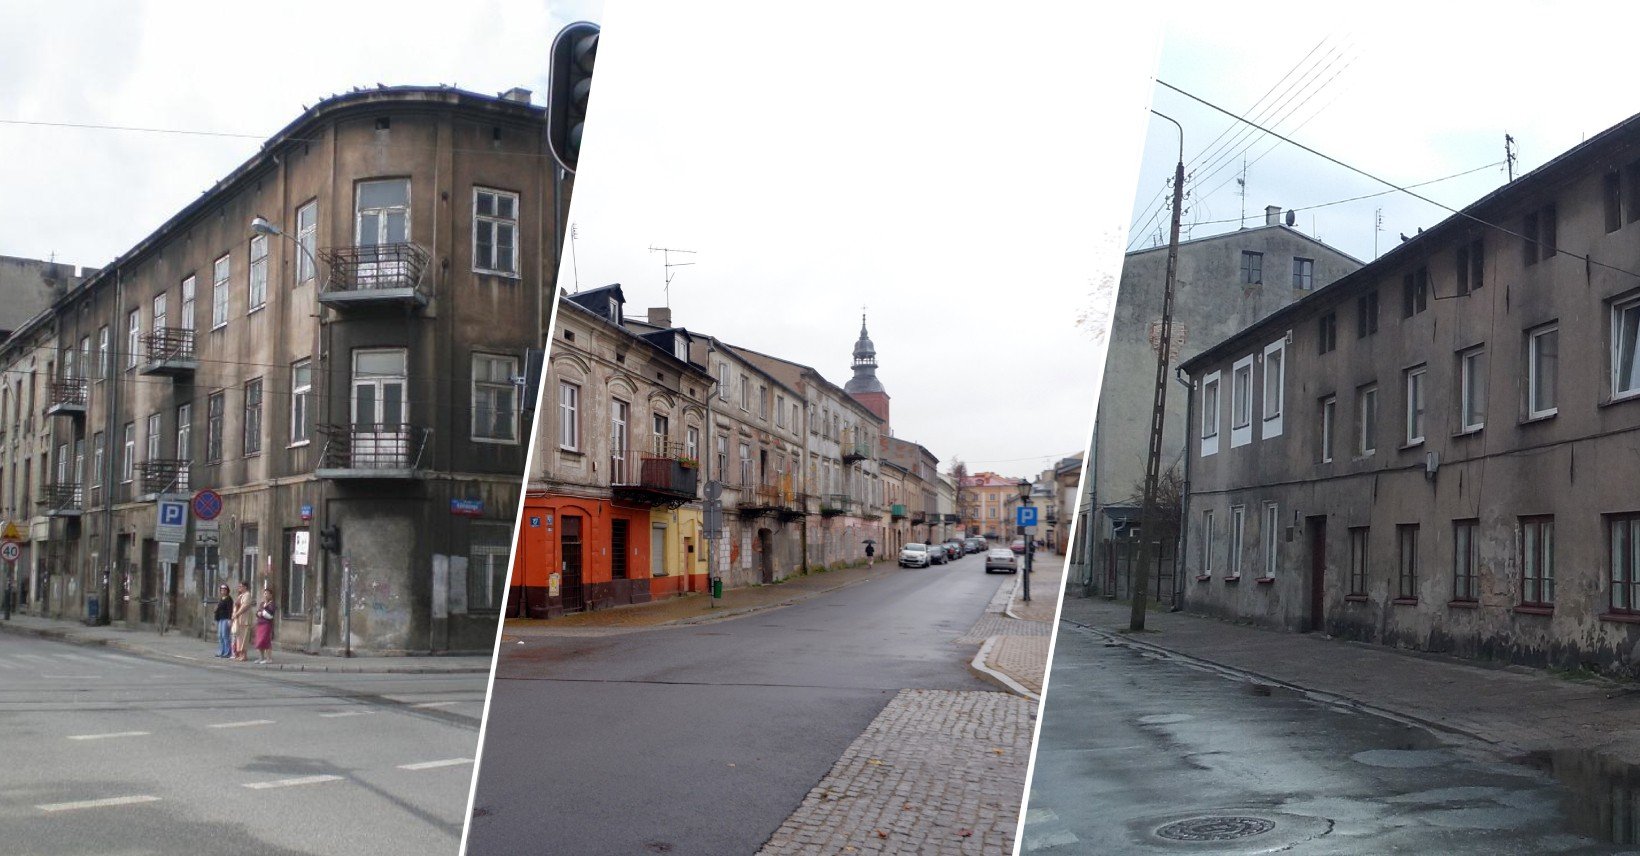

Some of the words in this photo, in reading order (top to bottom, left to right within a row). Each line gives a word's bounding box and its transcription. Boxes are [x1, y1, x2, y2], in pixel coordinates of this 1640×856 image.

[166, 505, 179, 522] P
[1021, 508, 1034, 523] P
[3, 546, 18, 557] 40
